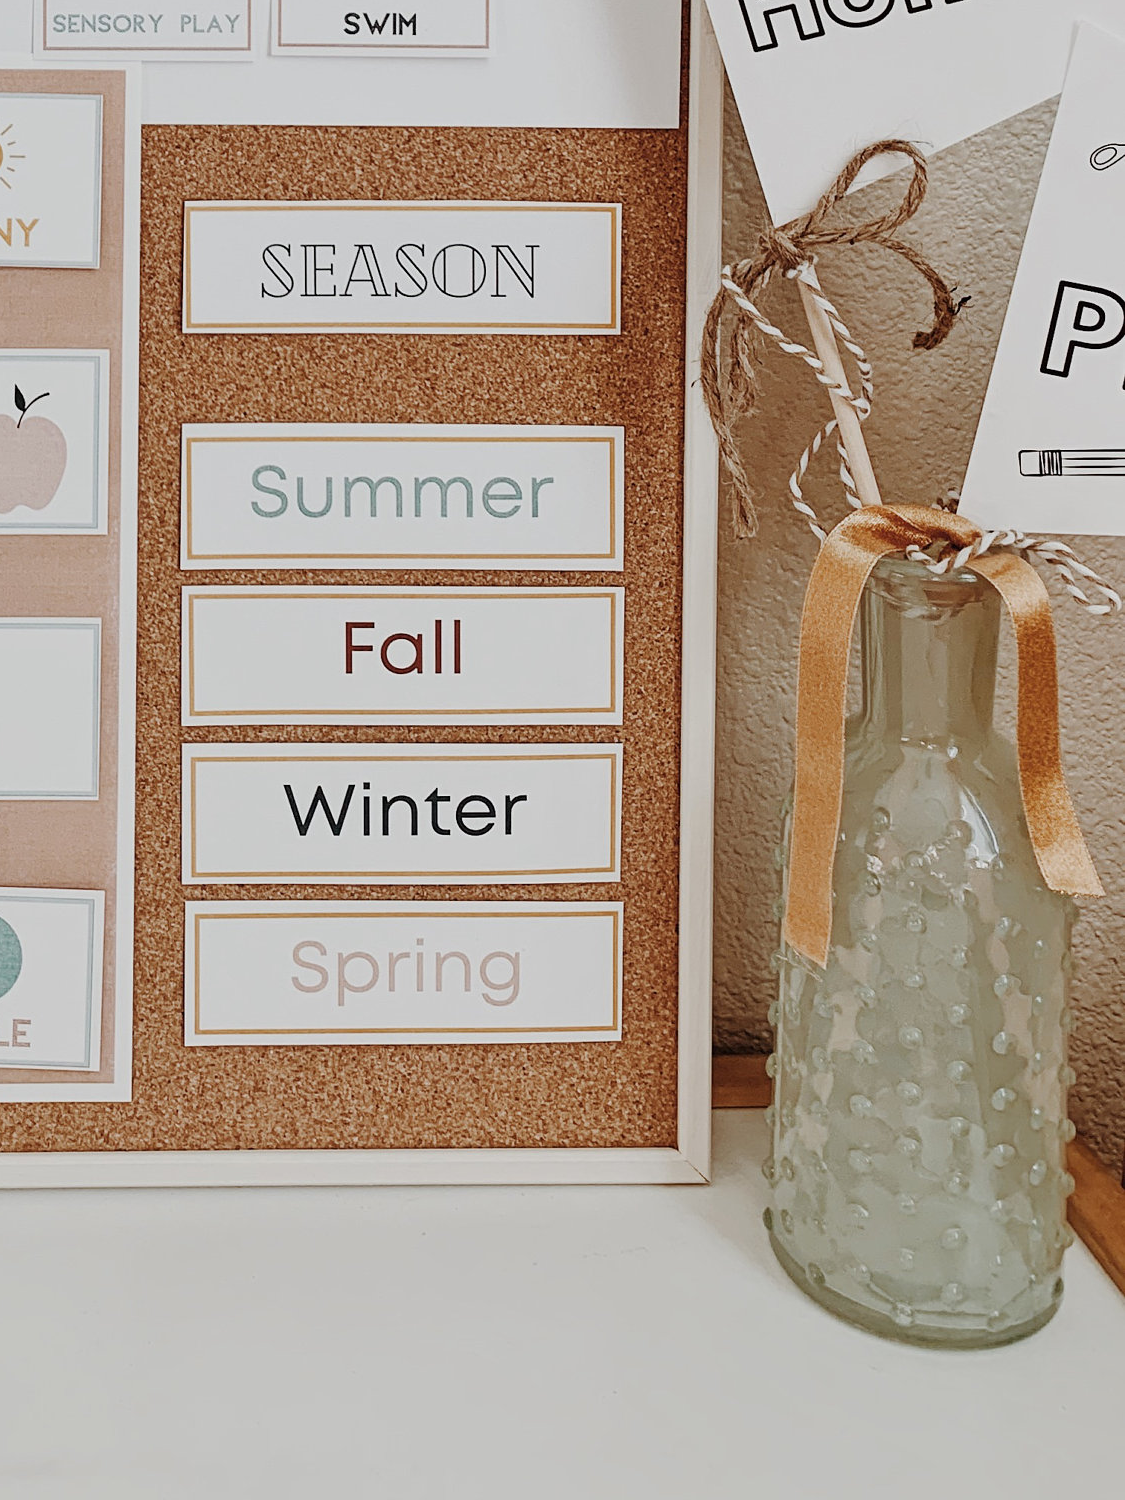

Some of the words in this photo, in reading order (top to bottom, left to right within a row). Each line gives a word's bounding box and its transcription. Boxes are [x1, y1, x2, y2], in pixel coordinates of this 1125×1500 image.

[53, 14, 163, 33] SENSORY
[181, 14, 240, 33] PLAY
[344, 13, 416, 35] SWIM
[262, 244, 540, 298] SEASON
[251, 465, 554, 518] Summer
[346, 620, 460, 674] Fall
[283, 782, 527, 836] Winter
[292, 938, 520, 1007] Spring
